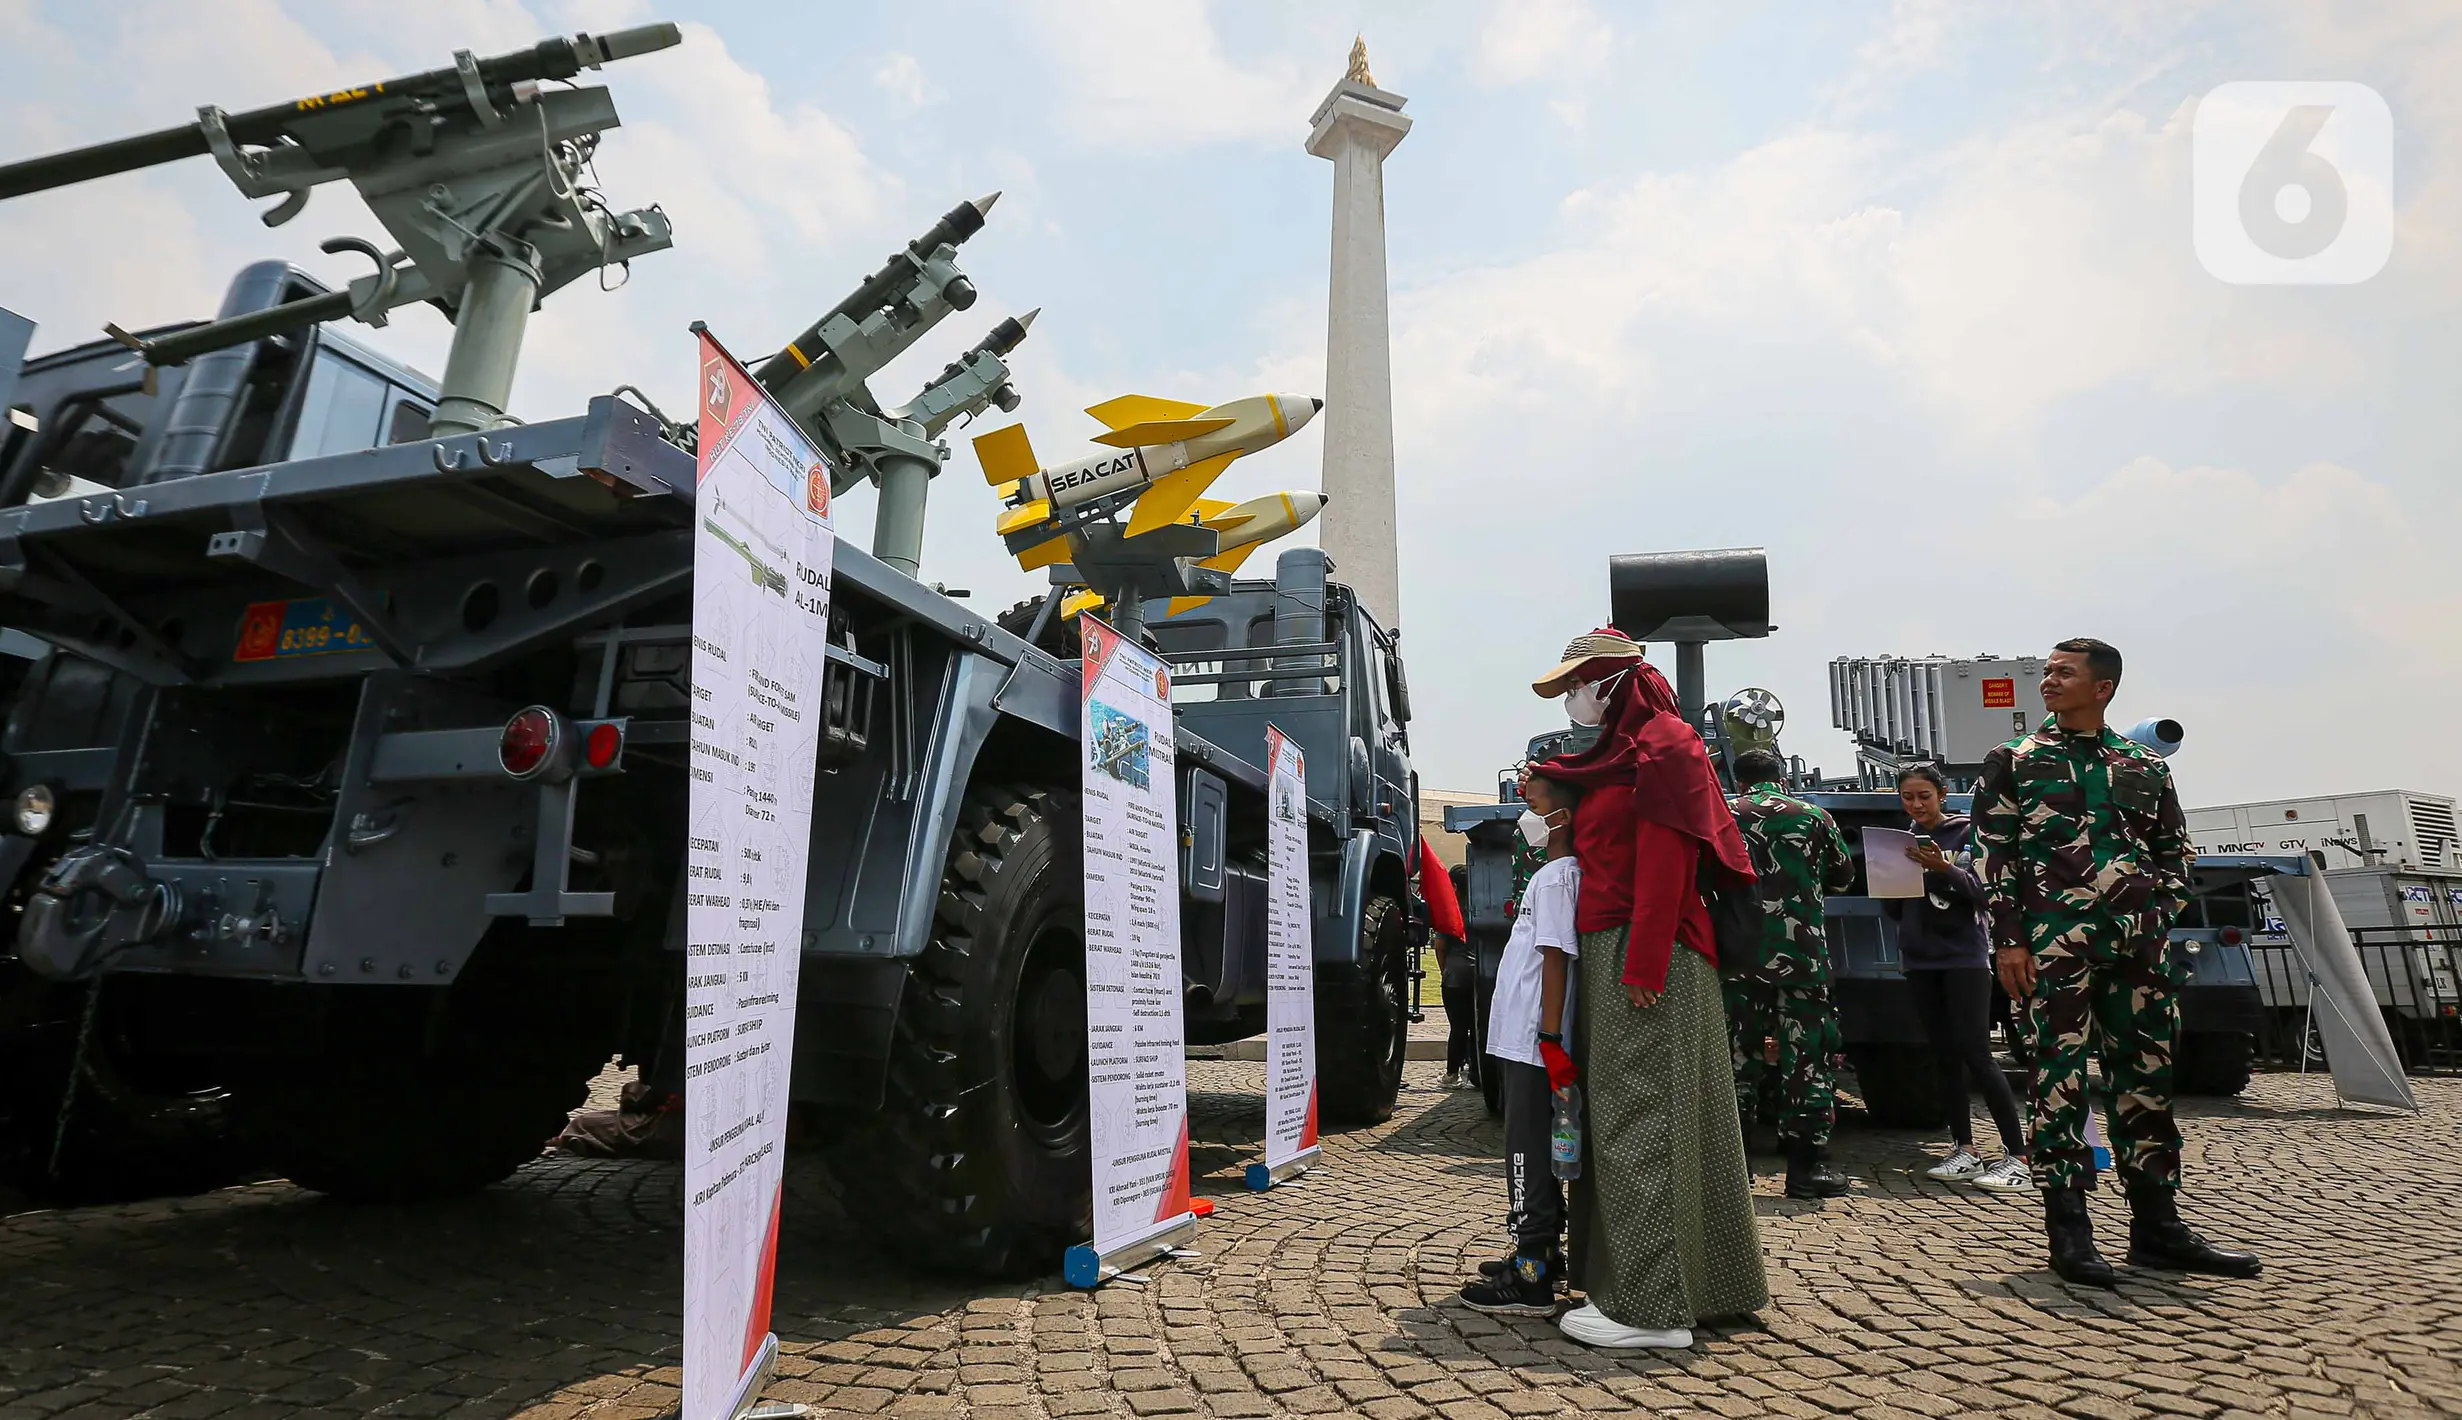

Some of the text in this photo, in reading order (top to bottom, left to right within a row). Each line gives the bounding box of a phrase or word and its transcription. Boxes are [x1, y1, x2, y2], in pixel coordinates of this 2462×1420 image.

[709, 438, 724, 462] HUT
[769, 431, 793, 456] PATRIOT
[1051, 452, 1134, 493] SEACAT
[796, 561, 831, 592] RUDAL
[795, 590, 828, 618] AL-1M
[281, 623, 372, 650] 8399-0
[694, 635, 727, 662] ENIS RUDAL
[1154, 731, 1172, 748] RUDAL
[758, 791, 774, 804] 1440
[761, 810, 770, 821] 72
[2279, 839, 2305, 850] GTV
[689, 865, 704, 879] ERAT
[705, 895, 731, 908] WARHEAD
[688, 975, 703, 989] ARAK
[687, 1033, 706, 1048] AUNCH
[687, 1063, 702, 1080] STEM
[1513, 1152, 1525, 1212] SPACE
